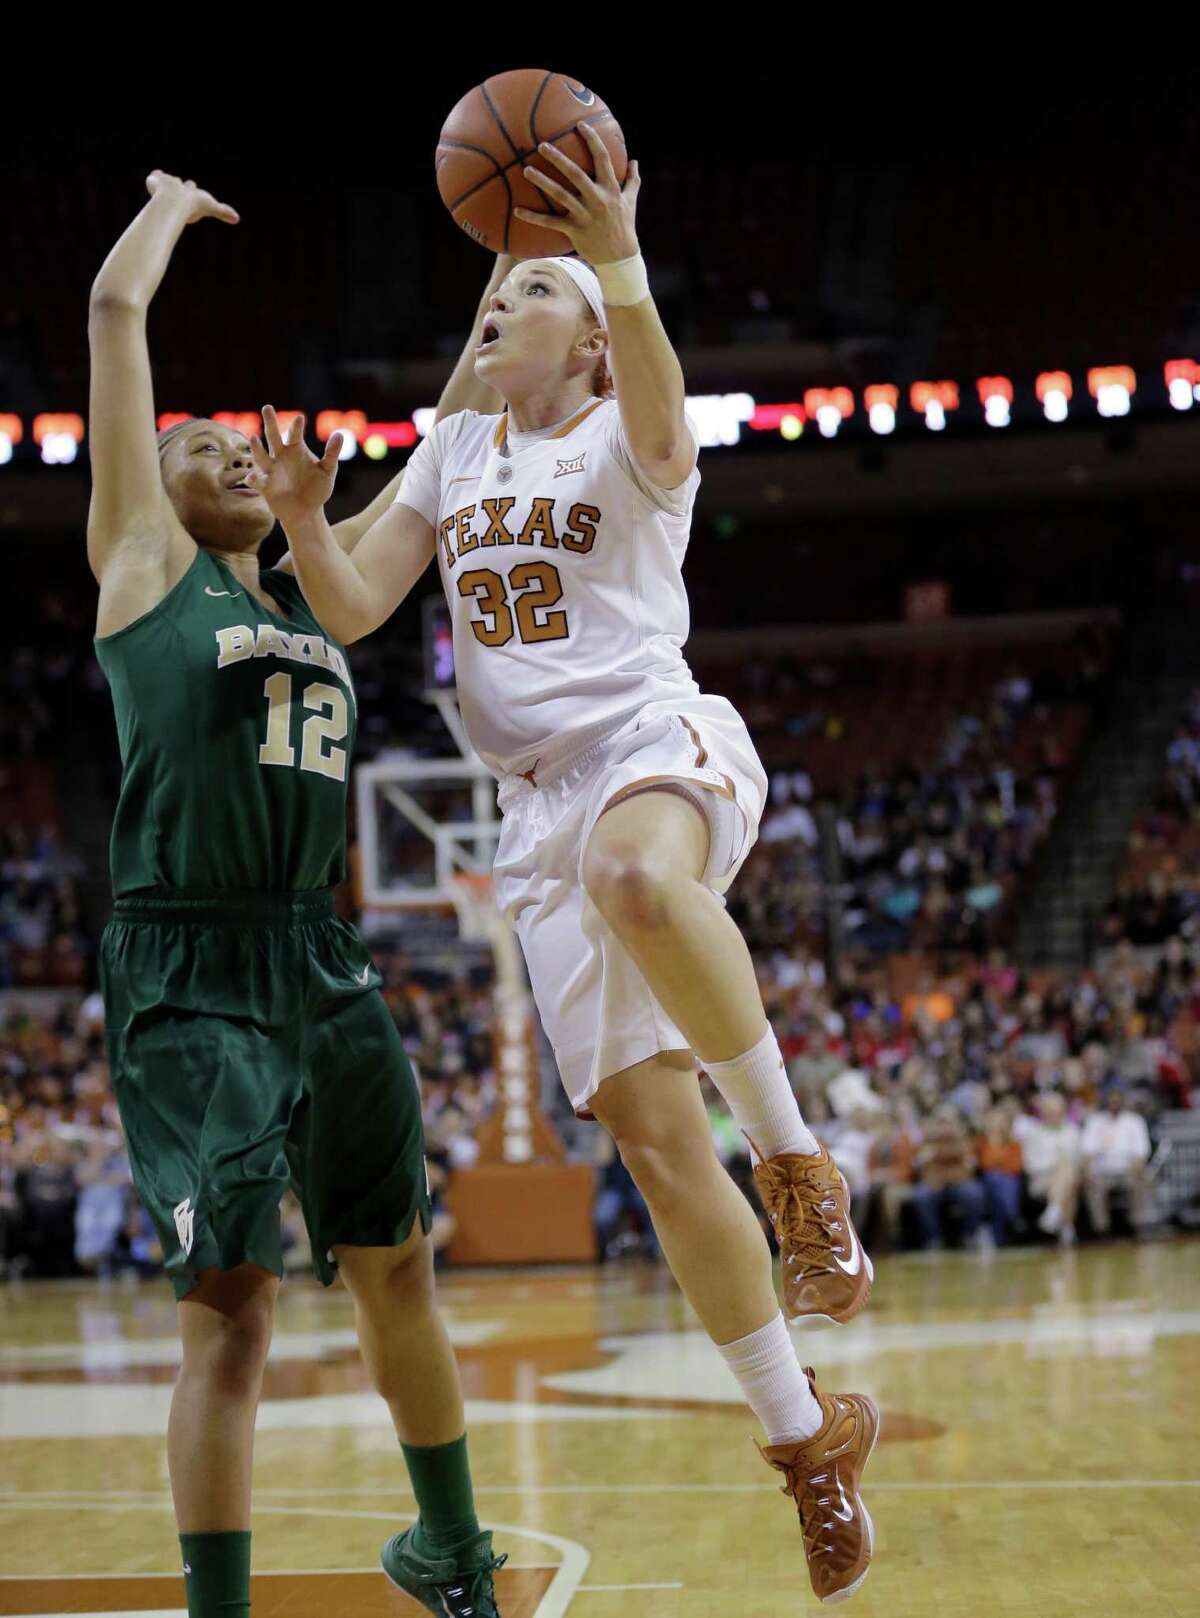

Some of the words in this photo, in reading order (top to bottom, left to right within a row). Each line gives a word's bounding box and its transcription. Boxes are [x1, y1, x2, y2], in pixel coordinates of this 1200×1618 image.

[440, 497, 601, 569] TEXAS
[456, 561, 569, 647] 32
[215, 624, 356, 712] BAYLO
[259, 672, 346, 782] 12
